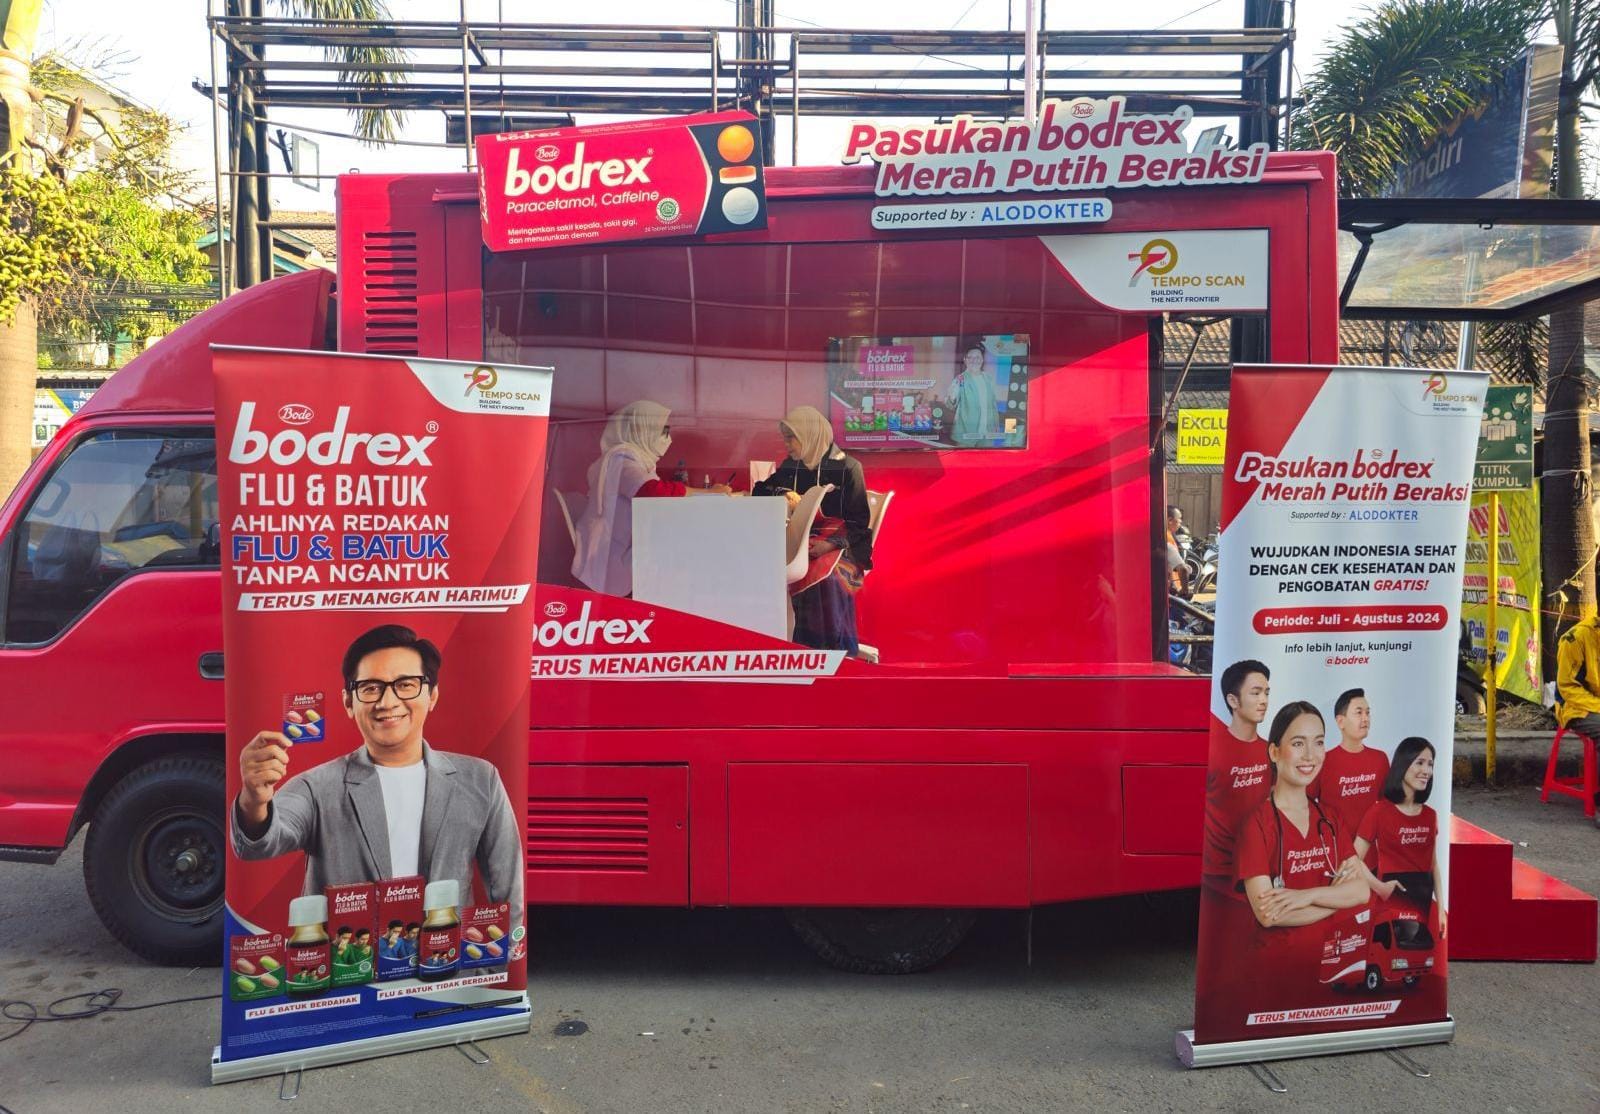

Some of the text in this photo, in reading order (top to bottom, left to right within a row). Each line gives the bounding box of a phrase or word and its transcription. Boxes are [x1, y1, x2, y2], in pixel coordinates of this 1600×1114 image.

[846, 101, 1185, 157] Pasukan bodrex
[504, 142, 652, 196] bodrex
[880, 147, 1264, 191] Merah Putih Beraksi
[506, 190, 659, 215] Paracetamol, Caffeine
[875, 208, 947, 224] Supported
[981, 202, 1104, 222] ALODOKTER
[508, 225, 555, 238] Meringankan
[556, 222, 574, 232] sakit
[508, 230, 600, 245] dan menurunkan demam
[1151, 275, 1245, 287] TEMPO SCAN
[1185, 295, 1220, 303] FRONTIER
[480, 391, 541, 401] TEMPO SCAN
[279, 407, 312, 422] Bode
[228, 401, 437, 467] bodrex
[1180, 436, 1221, 447] LINDA
[1240, 449, 1434, 479] Pasukan bodrex
[1480, 465, 1512, 475] TITIK
[239, 472, 429, 507] FLU & BATUK
[1472, 477, 1523, 487] KUMPUL
[1261, 481, 1469, 502] Merah Putih Beraksi
[1290, 511, 1331, 521] Supported
[1349, 510, 1419, 521] ALODOKTER
[231, 514, 449, 533] AHLINYA REDAKAN
[232, 533, 450, 562] FLU & BATUK
[1250, 546, 1330, 558] WUJUDKAN
[1334, 545, 1410, 557] INDONESIA
[1415, 545, 1457, 557] SEHAT
[232, 562, 449, 585] TANPA NGANTUK
[1249, 562, 1456, 576] DENGAN CEK KESEHATAN DAN
[1278, 580, 1429, 593] PENGOBATAN GRATIS!
[251, 587, 518, 609] TERUS MENANGKAN HARIMU!
[1264, 615, 1314, 627] Periode:
[1317, 614, 1341, 625] Juli
[1353, 614, 1403, 627] Agustus
[1406, 612, 1440, 624] 2024
[1285, 641, 1412, 654] Info lebih lanjut, kunjungi
[531, 653, 827, 675] ERUS MENANGKAN HARIMU!
[1325, 656, 1369, 666] @bodrex
[1231, 763, 1268, 775] Pasukan
[1339, 773, 1376, 784] Pasukan
[1399, 826, 1430, 835] Pasukan
[1287, 846, 1330, 860] Pasukan
[379, 990, 394, 999] FLU
[406, 986, 433, 995] BATUK
[436, 981, 460, 990] TIDAK
[462, 975, 505, 986] BERDAHAK
[249, 1008, 266, 1017] FLU
[278, 1003, 308, 1013] BATUK
[310, 997, 358, 1009] BERDAHAK
[1254, 1003, 1392, 1023] TERUS MENANGKAN HARIMU!
